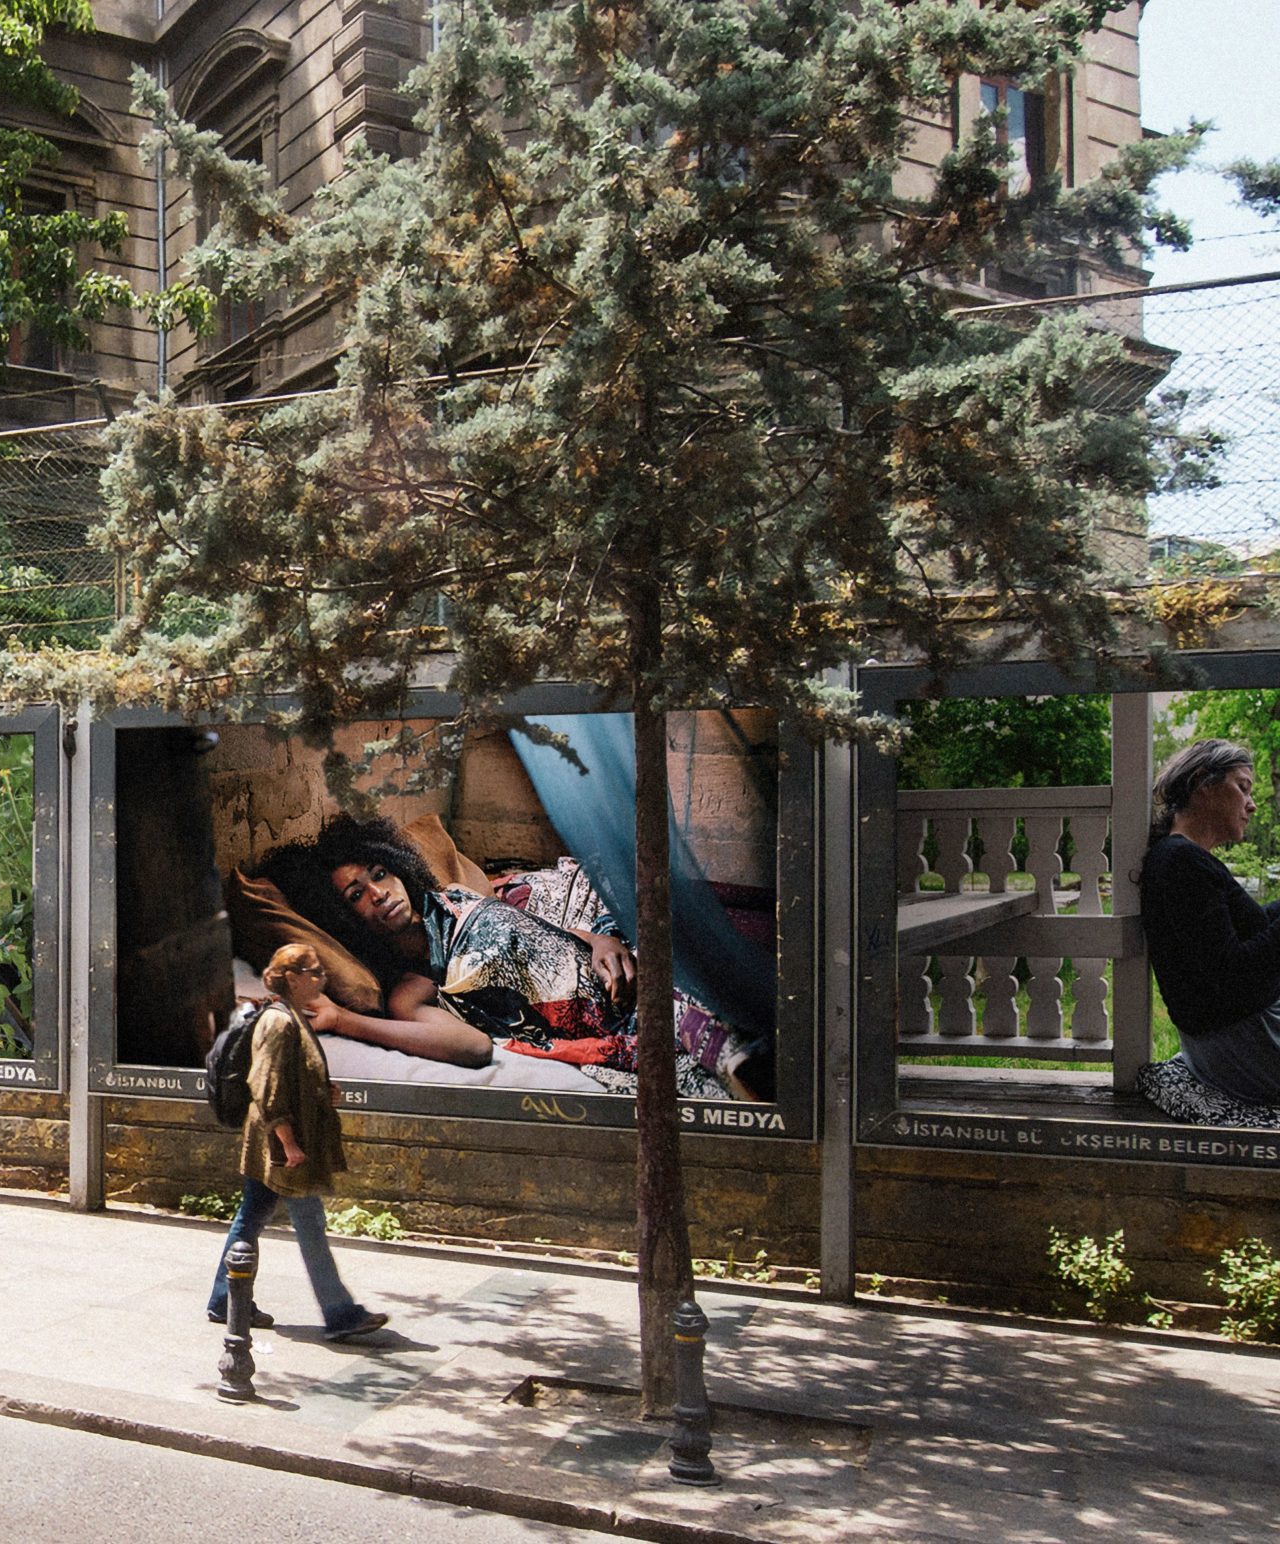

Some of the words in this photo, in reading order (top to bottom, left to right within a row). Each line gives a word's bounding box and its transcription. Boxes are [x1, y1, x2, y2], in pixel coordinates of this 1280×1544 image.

[703, 1108, 786, 1131] MEDYA
[913, 1120, 1010, 1144] İSTANBUL
[1159, 1139, 1280, 1160] BELEDİYES
